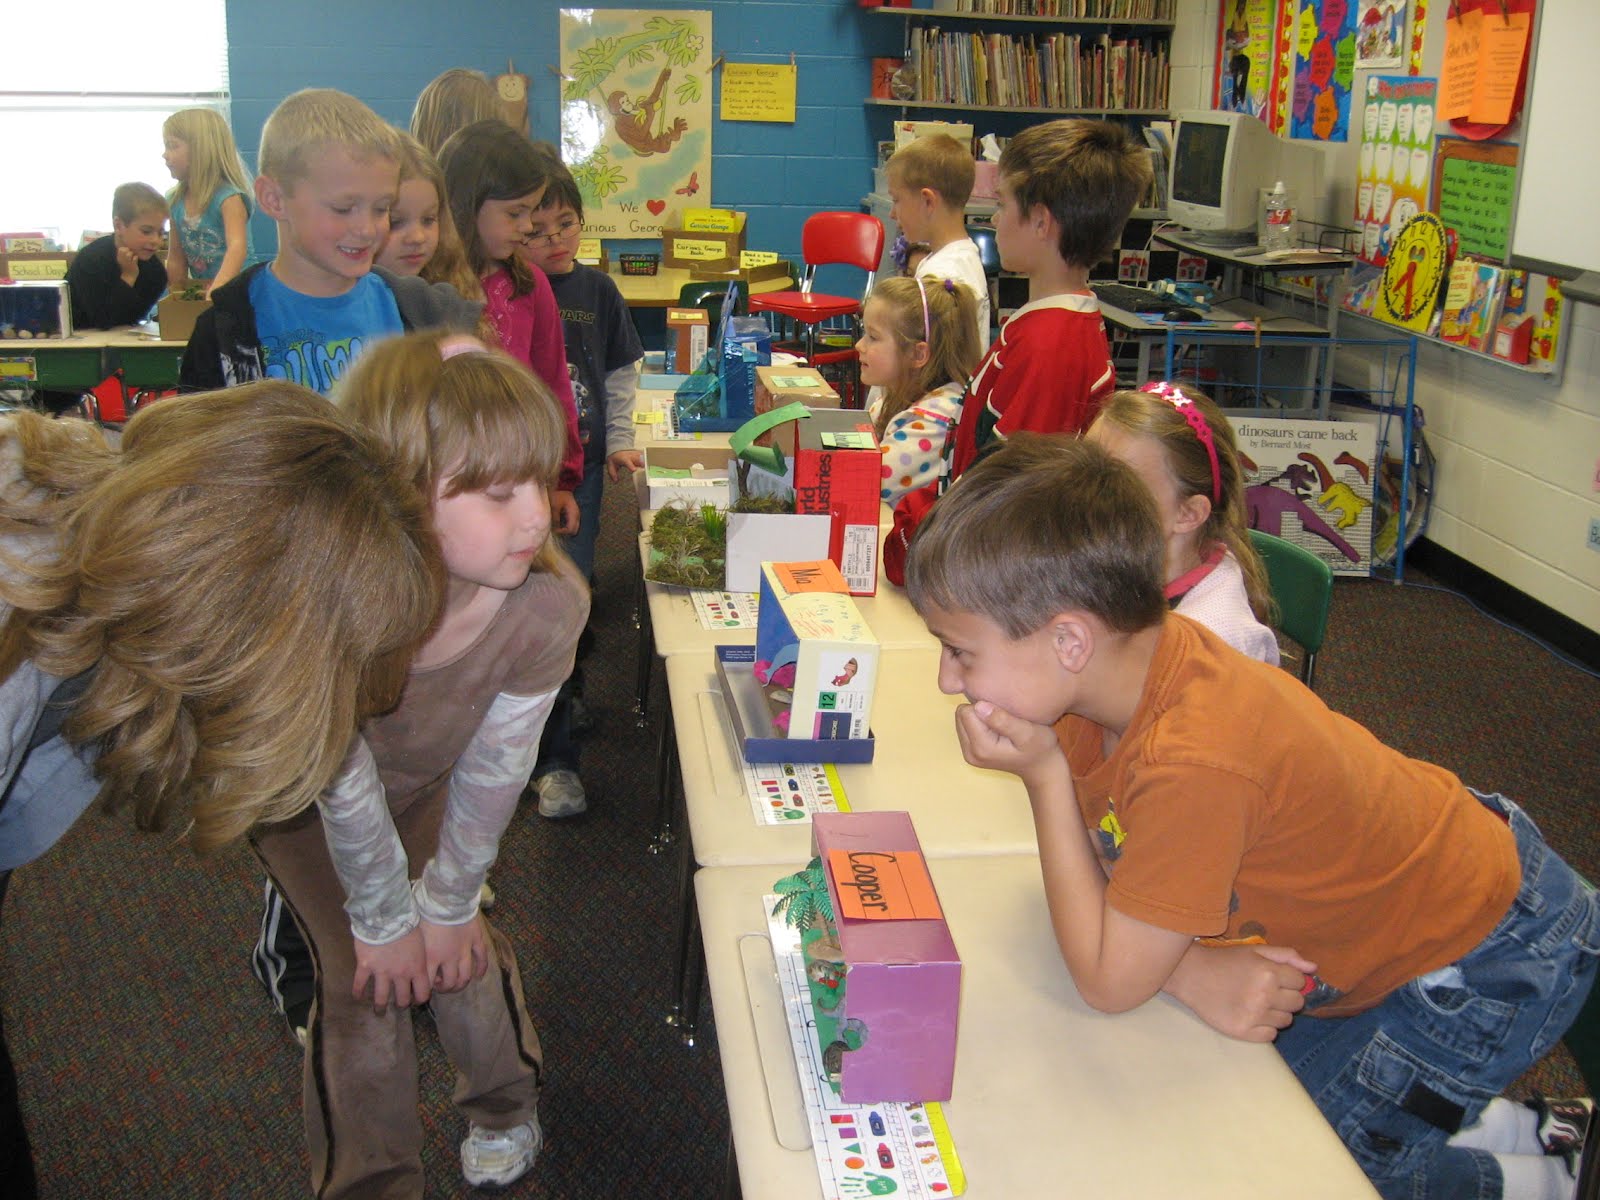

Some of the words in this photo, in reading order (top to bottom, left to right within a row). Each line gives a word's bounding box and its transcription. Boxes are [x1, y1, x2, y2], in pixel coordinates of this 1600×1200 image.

[620, 201, 639, 213] We
[629, 219, 664, 238] Georg
[1420, 222, 1428, 235] 12
[1238, 424, 1294, 438] dinosaurs
[1297, 429, 1328, 440] came
[1331, 428, 1358, 441] back
[1250, 439, 1259, 448] by
[1261, 440, 1291, 449] Bernard
[1293, 441, 1312, 449] Most
[815, 454, 832, 515] ustries
[799, 487, 815, 515] rld
[821, 694, 834, 707] 12
[841, 851, 897, 912] Cooper
